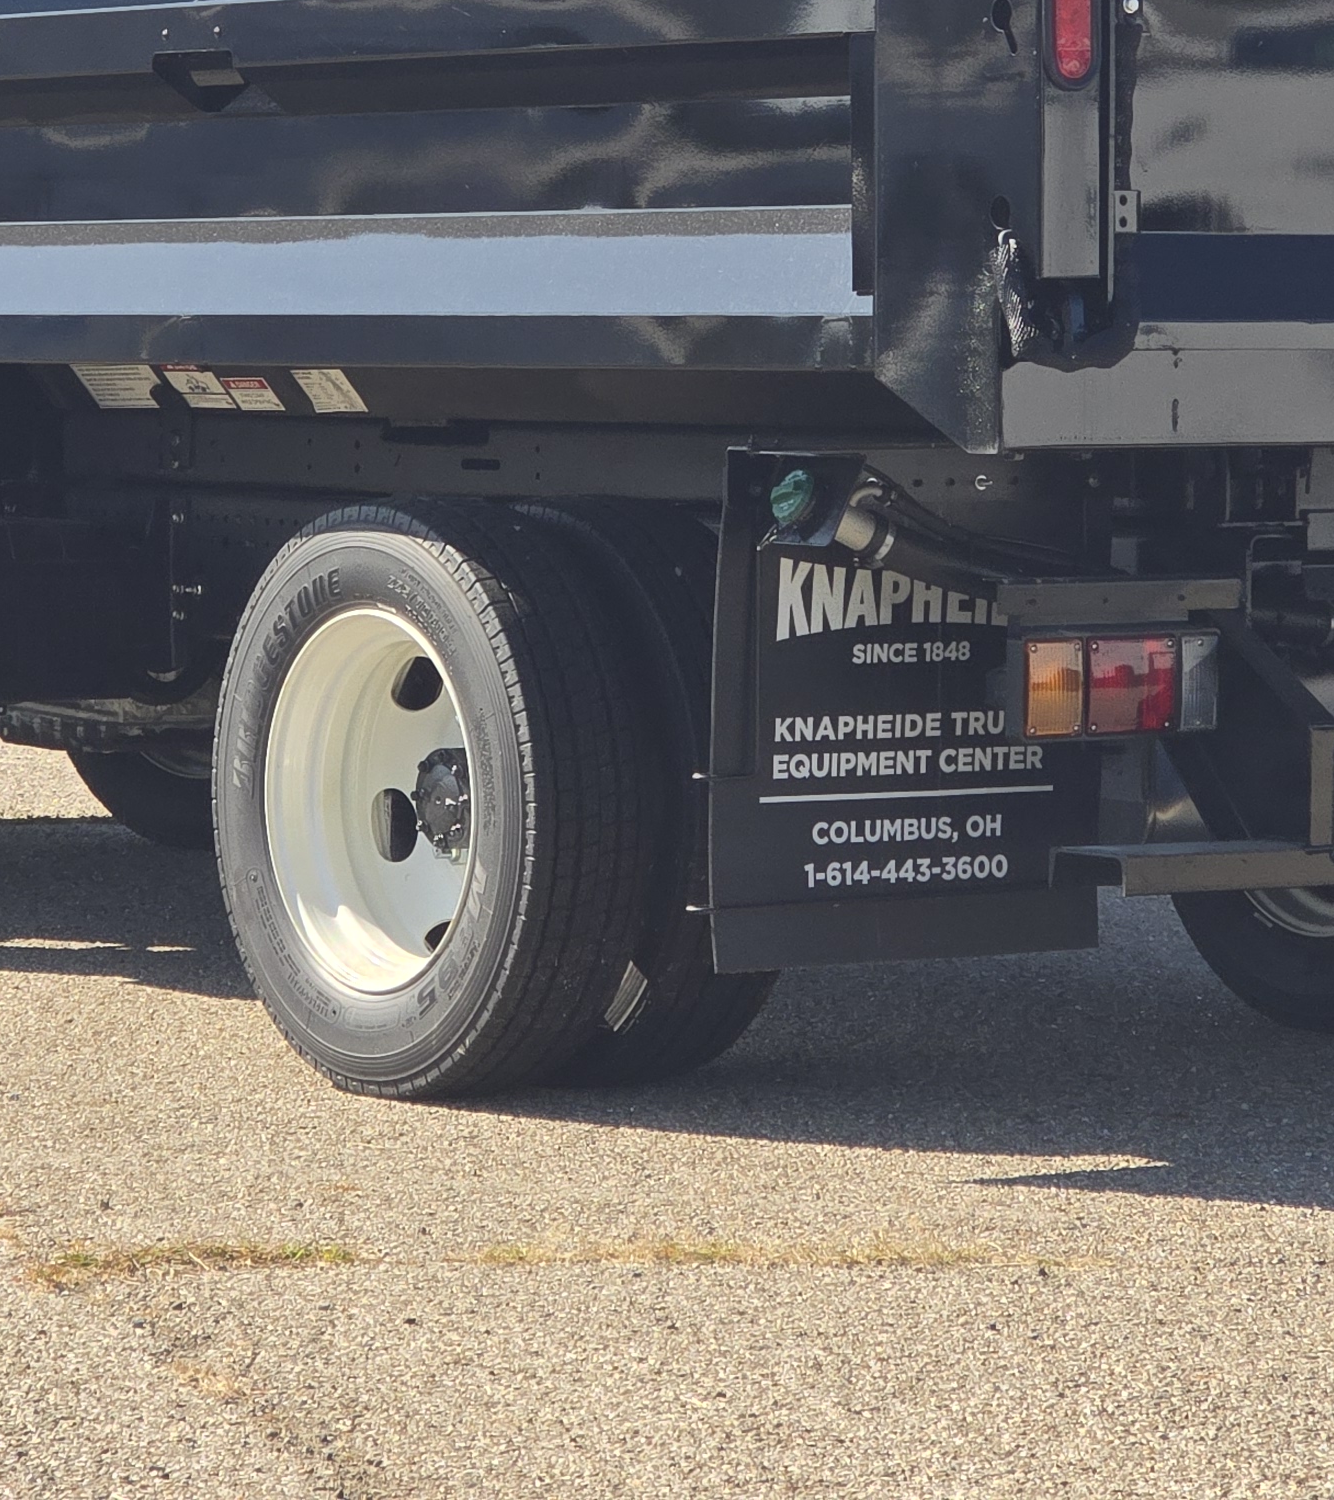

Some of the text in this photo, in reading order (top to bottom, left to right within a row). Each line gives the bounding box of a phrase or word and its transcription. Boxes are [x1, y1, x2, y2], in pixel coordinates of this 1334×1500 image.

[852, 641, 971, 665] SINCE 1848
[774, 710, 1005, 743] KNAPHEIDE TRU
[772, 745, 1043, 780] EQUIPMENT CENTER
[812, 814, 1002, 845] COLUMBUS, OH
[804, 854, 1009, 888] 1-614-443-3600
